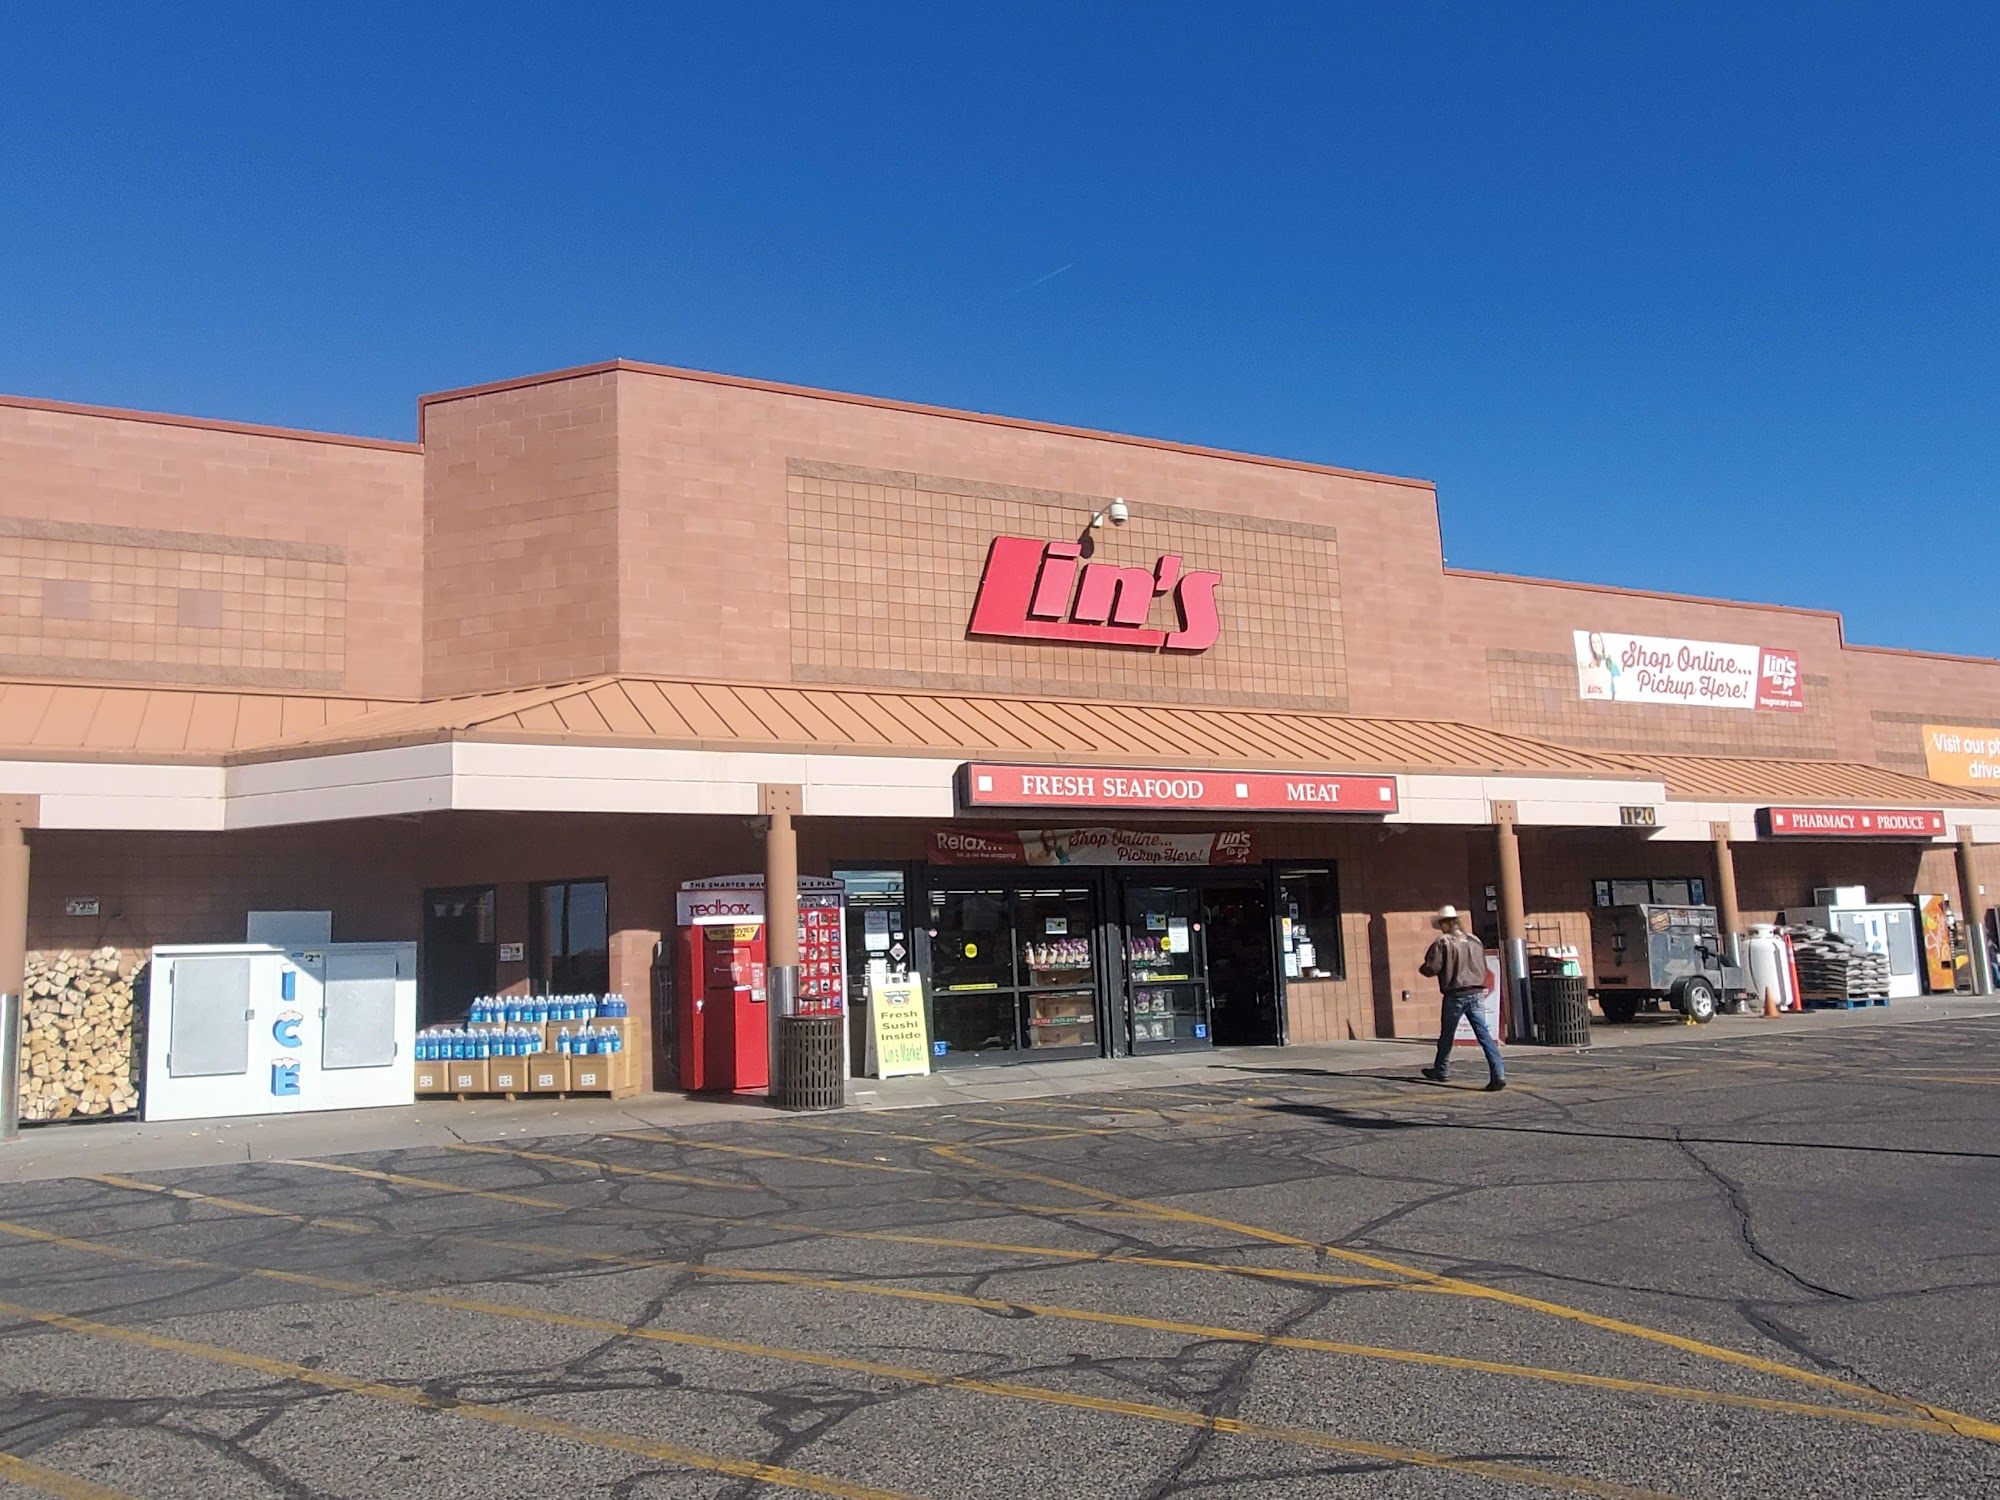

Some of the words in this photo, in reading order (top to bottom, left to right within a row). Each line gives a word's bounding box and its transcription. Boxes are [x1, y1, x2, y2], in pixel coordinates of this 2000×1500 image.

[966, 535, 1222, 653] Lin's
[1621, 641, 1674, 674] Shop
[1677, 646, 1752, 676] Online...
[1763, 654, 1797, 678] Lin's
[1637, 669, 1697, 700] Pickup
[1699, 675, 1749, 699] Here!
[1933, 733, 1961, 753] Visit
[1963, 738, 1985, 754] our
[1021, 775, 1095, 798] FRESH
[1102, 777, 1204, 800] SEAFOOD
[1287, 783, 1341, 802] MEAT
[1621, 807, 1655, 825] 1120
[1792, 813, 1856, 829] PHARMACY
[1877, 815, 1926, 831] PRODUCE
[936, 832, 1002, 851] Relax...
[1069, 830, 1109, 848] Shop
[1111, 831, 1172, 847] Online...
[1215, 831, 1251, 850] Lin's
[1117, 847, 1161, 863] Pickup
[1164, 848, 1203, 862] Here!
[881, 1010, 918, 1019] Fresh
[272, 962, 303, 1096] ICE
[882, 1021, 918, 1030] Sushi
[881, 1032, 921, 1041] Inside
